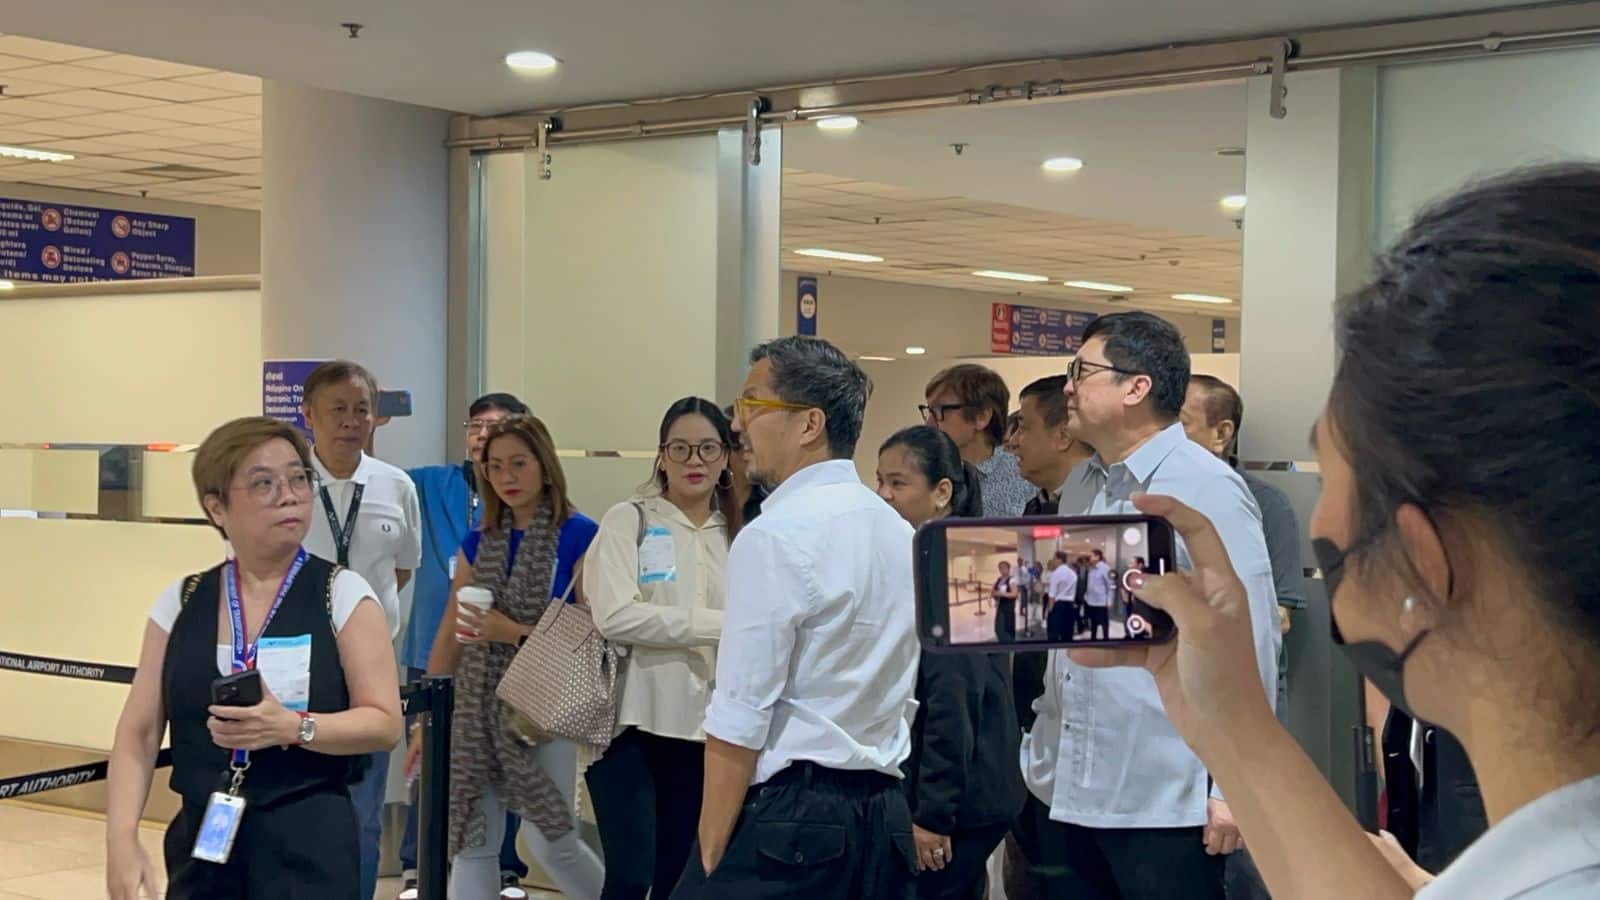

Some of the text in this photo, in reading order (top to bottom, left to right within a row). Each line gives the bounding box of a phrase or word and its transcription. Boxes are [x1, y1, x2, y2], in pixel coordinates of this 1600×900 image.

[148, 221, 169, 231] Sharp
[132, 229, 156, 239] Object
[26, 660, 60, 673] AIRPORT
[60, 663, 105, 678] AUTHORITY
[18, 768, 97, 795] AUTHORITY
